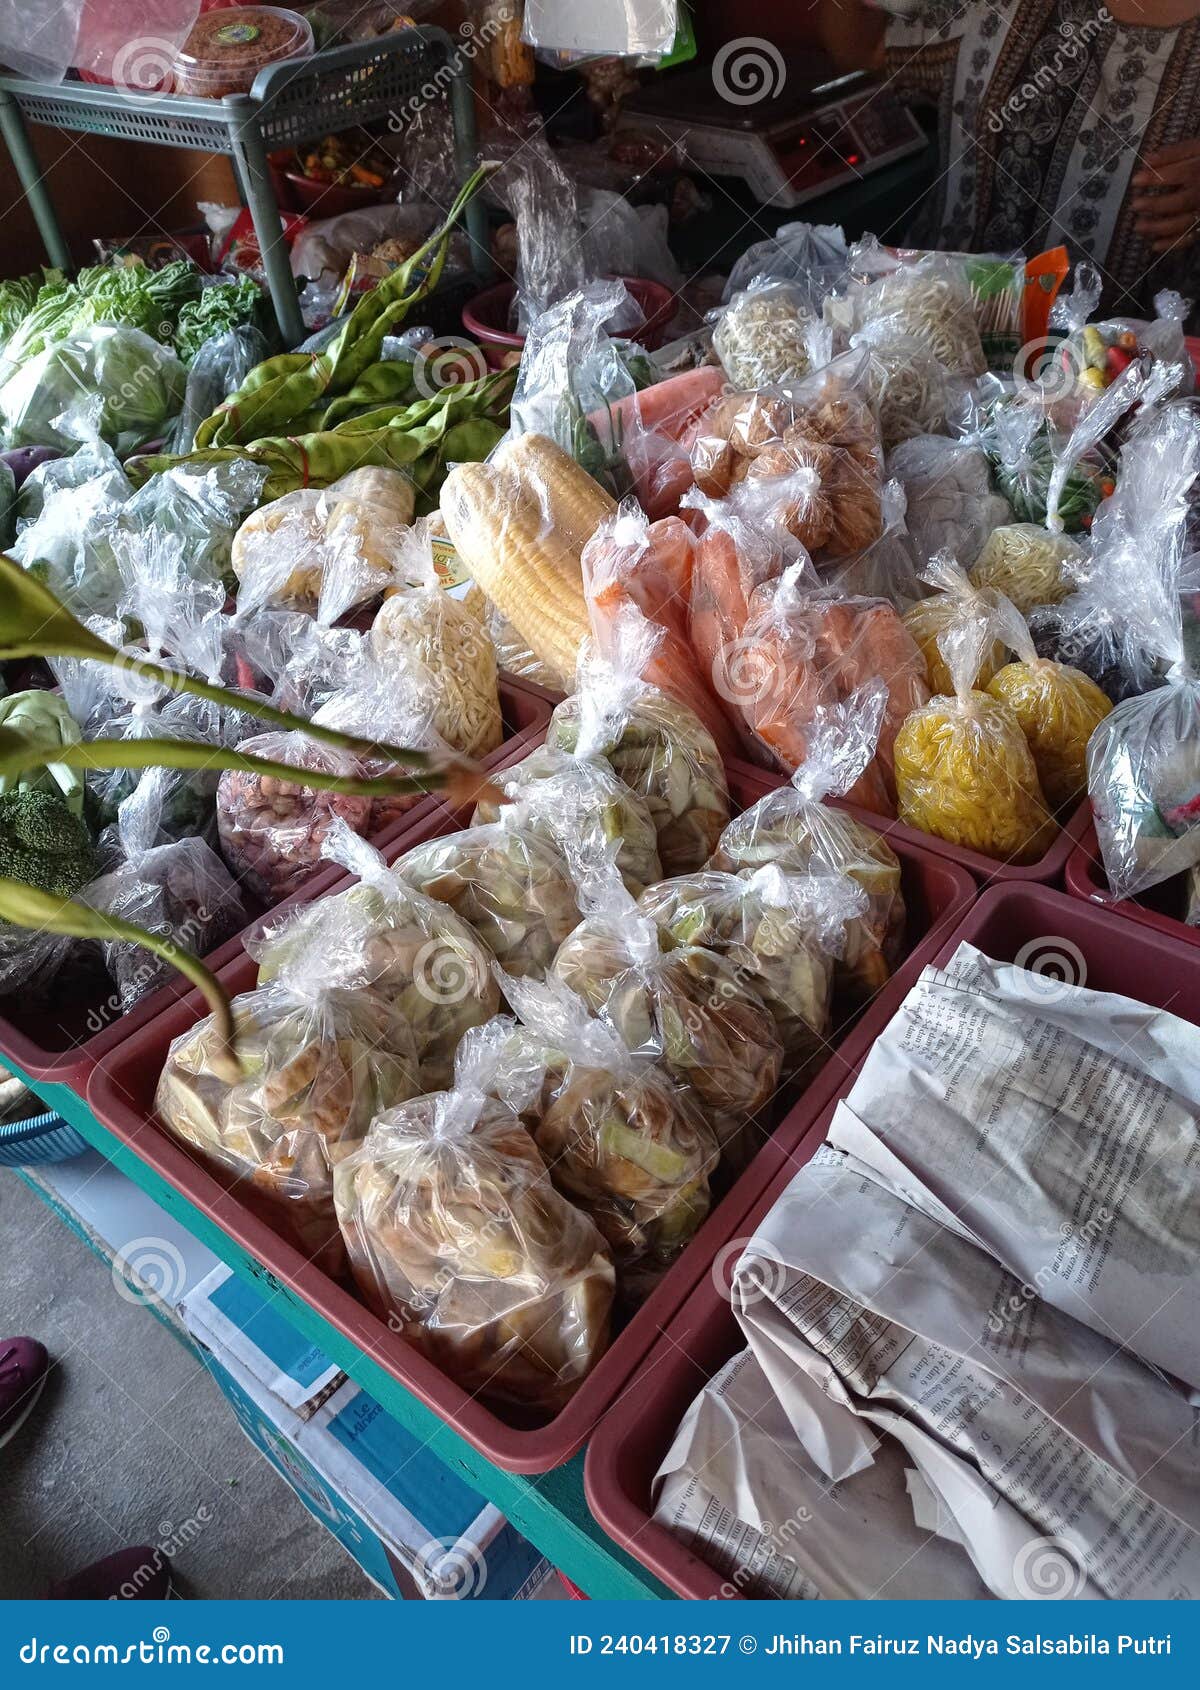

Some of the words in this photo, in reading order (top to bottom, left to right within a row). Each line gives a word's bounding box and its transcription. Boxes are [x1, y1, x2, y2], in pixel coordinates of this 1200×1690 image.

[904, 1024, 916, 1039] dan
[914, 1028, 926, 1043] dan
[924, 1032, 936, 1046] dan
[954, 1019, 968, 1042] benar
[942, 1086, 956, 1103] dan
[874, 1337, 897, 1362] Waktu
[912, 1356, 930, 1373] dan
[925, 1365, 941, 1383] dan
[936, 1405, 962, 1433] Dhuha
